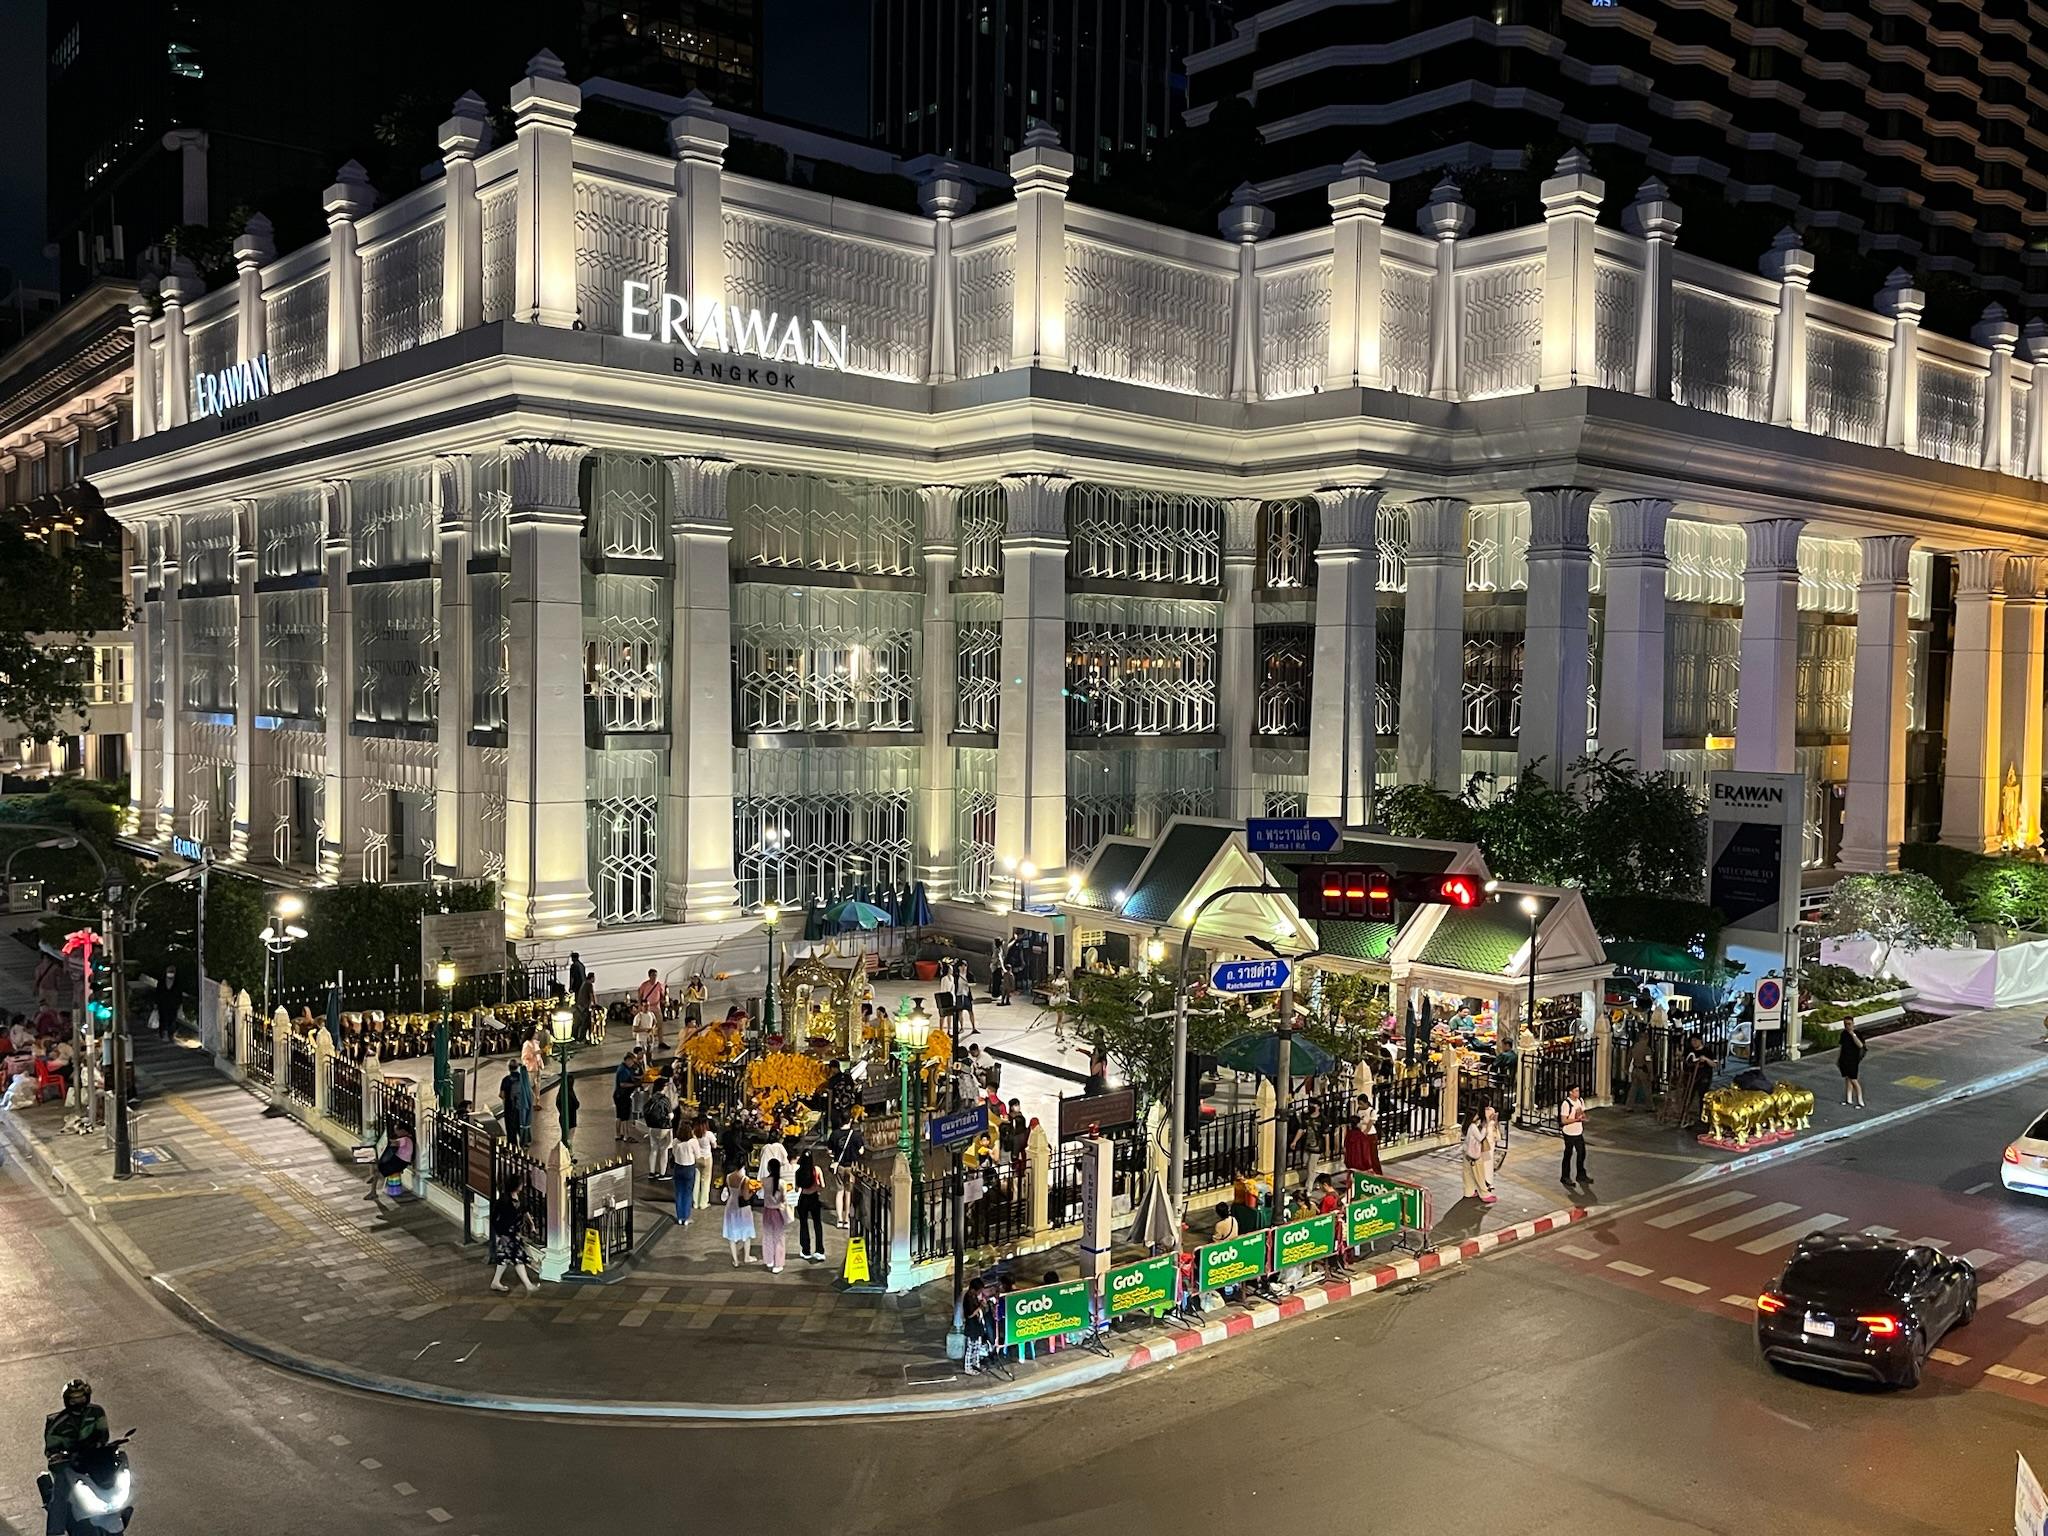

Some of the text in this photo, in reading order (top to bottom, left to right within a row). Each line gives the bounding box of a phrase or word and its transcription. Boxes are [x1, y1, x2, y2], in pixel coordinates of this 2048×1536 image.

[622, 279, 849, 373] ERAWAN
[674, 357, 796, 389] BANGKOK
[196, 353, 269, 417] ERAWAN
[1714, 783, 1783, 803] ERAWAN
[1717, 866, 1760, 878] WELCOME
[1761, 870, 1774, 879] TO
[1361, 1180, 1388, 1195] Grab
[1086, 1173, 1094, 1237] EMERGENCY
[1354, 1204, 1377, 1221] Grab
[1283, 1226, 1309, 1245] Grab
[1208, 1246, 1238, 1266] Grab
[1113, 1270, 1143, 1290] Grab
[1016, 1295, 1053, 1315] Grab
